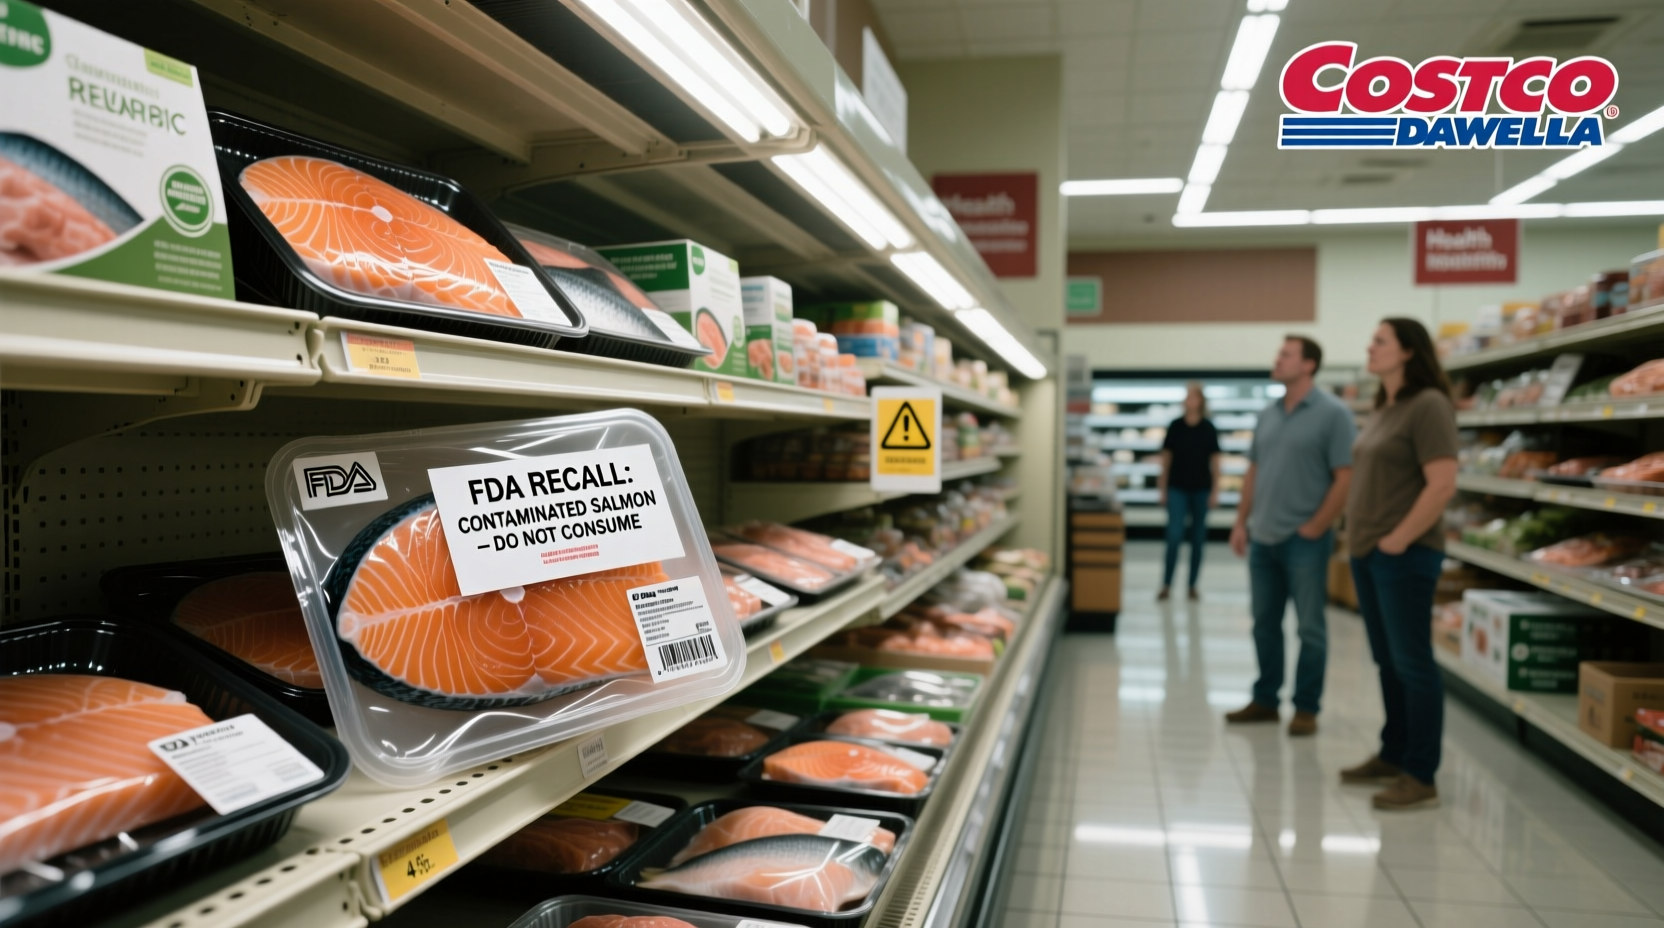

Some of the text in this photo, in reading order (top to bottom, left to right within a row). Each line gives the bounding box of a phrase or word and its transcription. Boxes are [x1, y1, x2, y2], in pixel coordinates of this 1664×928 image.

[303, 461, 377, 498] FDA
[468, 462, 634, 505] FDA RECALL:
[458, 490, 657, 534] CONTAMINATED SALMON
[493, 532, 519, 552] DO
[523, 526, 556, 547] NOT
[561, 513, 643, 540] CONSUME
